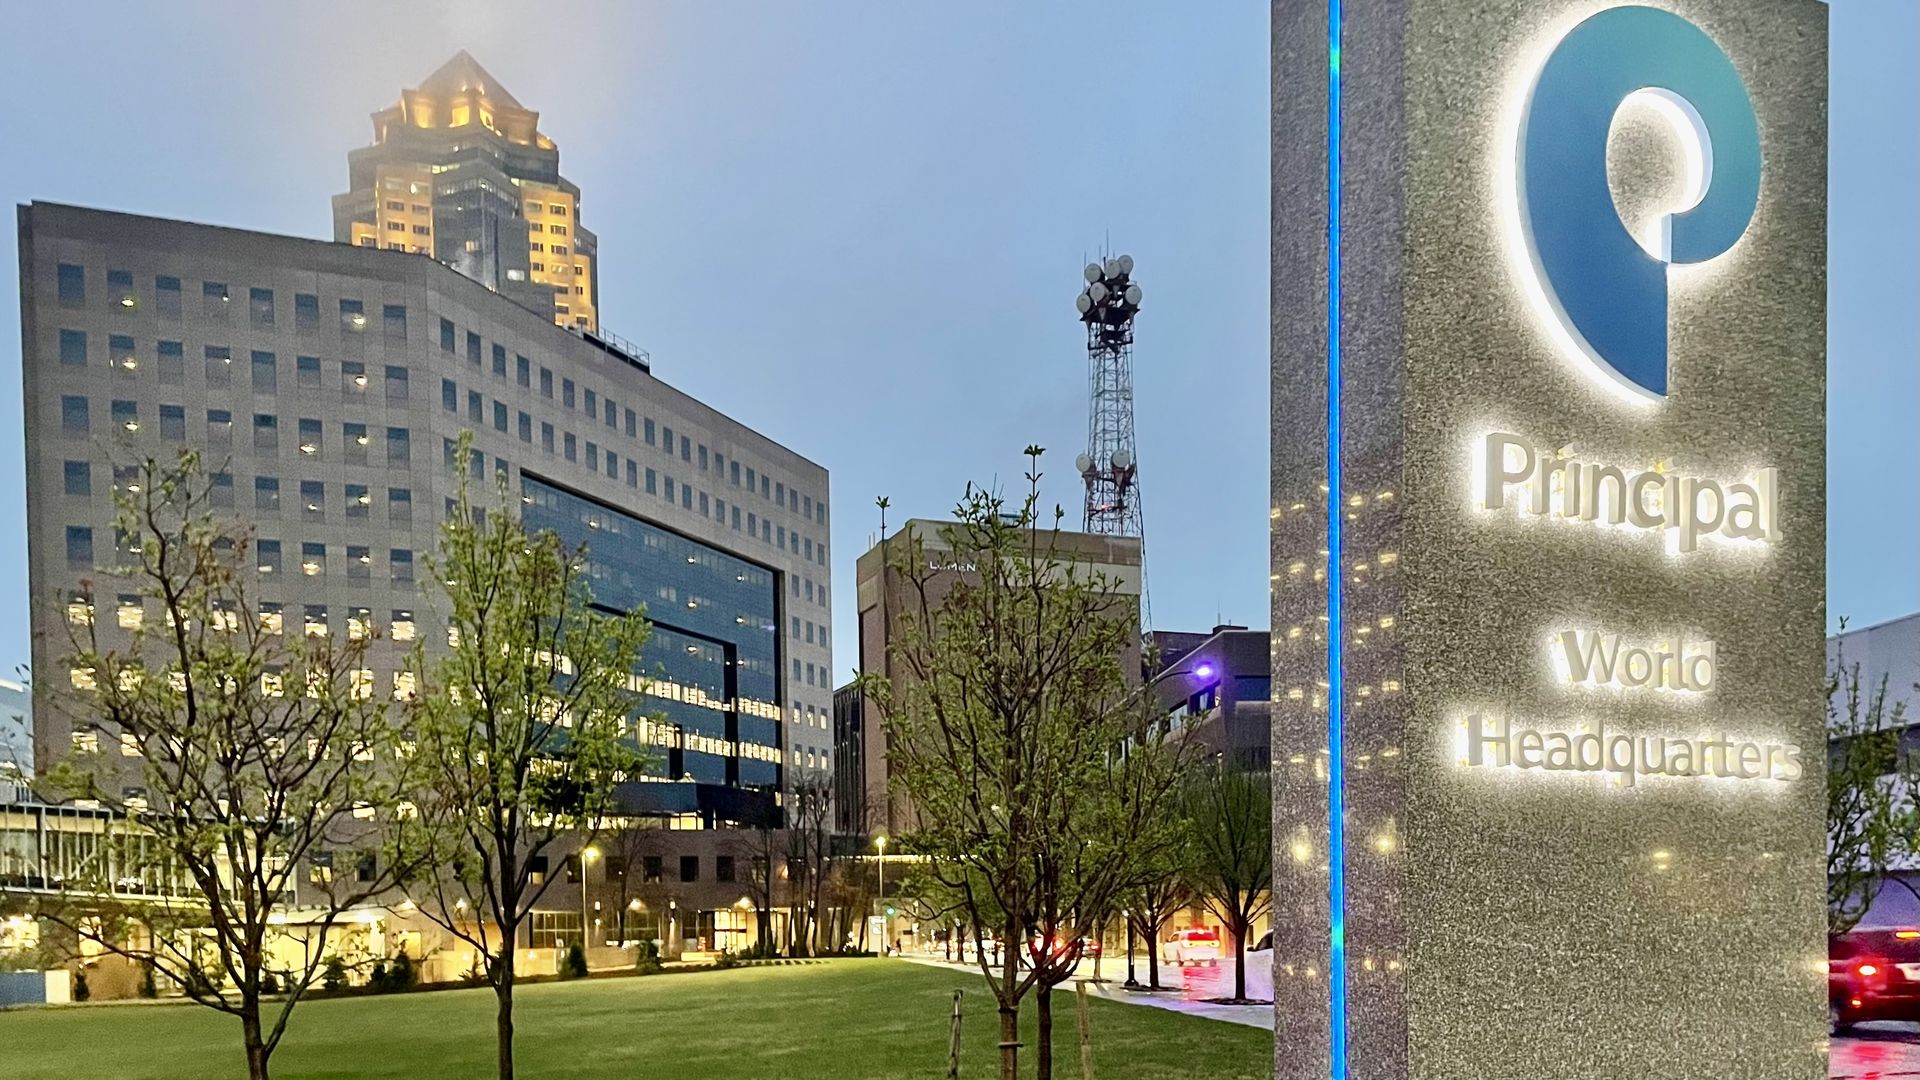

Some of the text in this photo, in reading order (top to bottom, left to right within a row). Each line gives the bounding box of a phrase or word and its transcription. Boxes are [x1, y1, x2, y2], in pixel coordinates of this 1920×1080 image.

[1485, 432, 1783, 553] Principal
[1559, 630, 1717, 692] World
[1466, 713, 1802, 787] Headquarters
